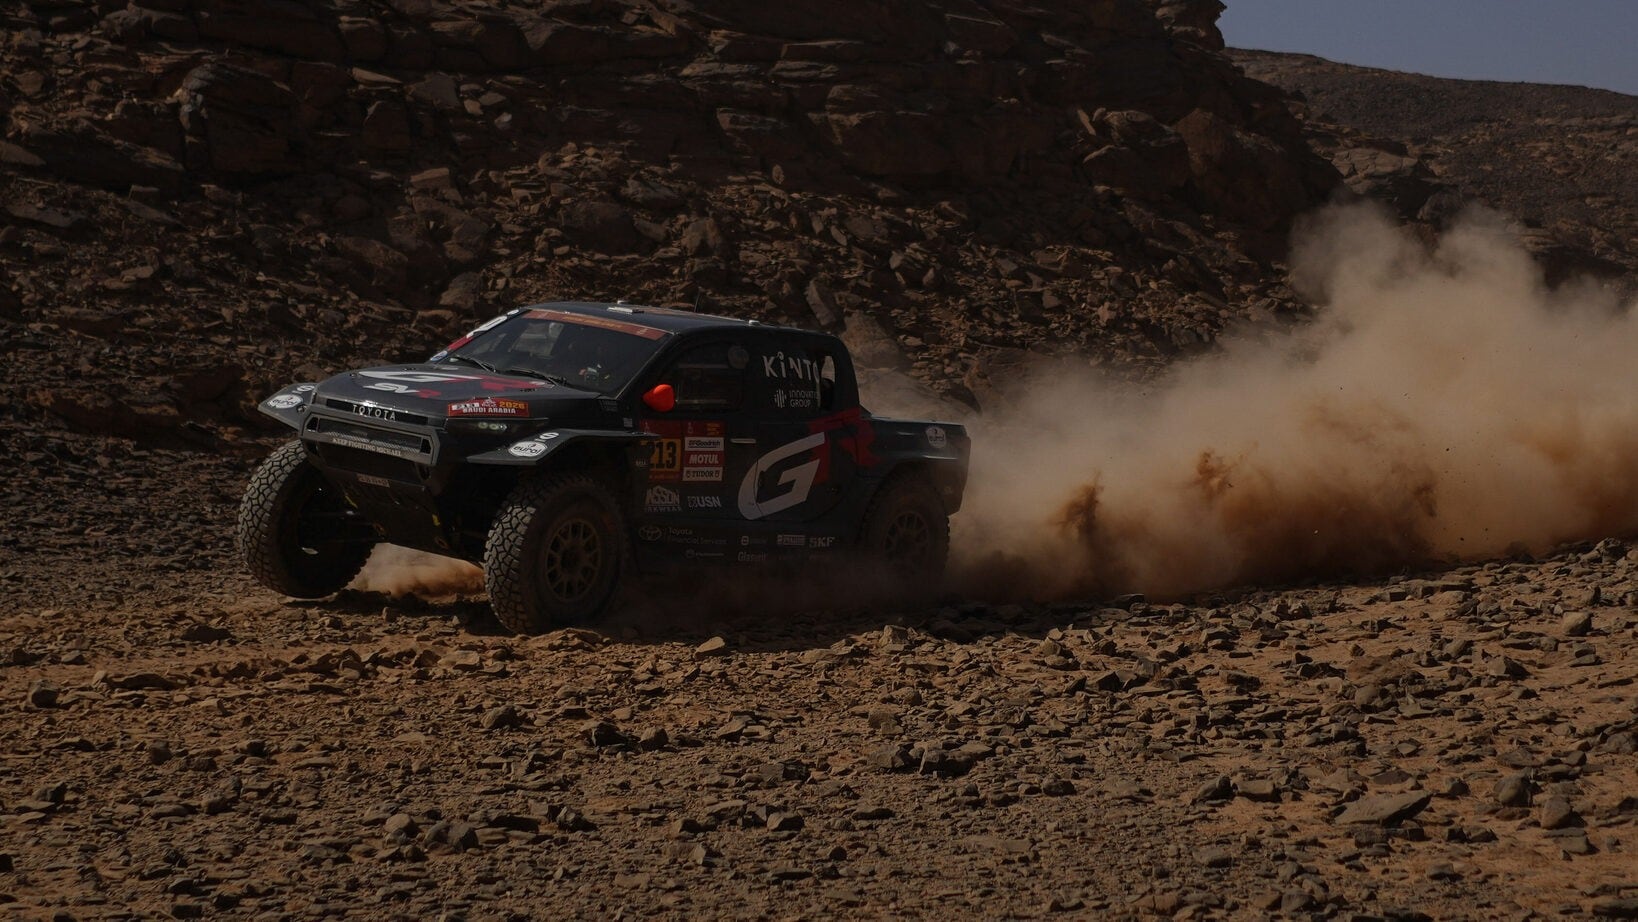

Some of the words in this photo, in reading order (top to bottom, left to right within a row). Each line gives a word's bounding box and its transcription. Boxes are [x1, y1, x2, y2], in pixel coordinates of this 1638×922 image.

[499, 401, 526, 410] 2026
[352, 404, 397, 421] TOYOTA
[348, 440, 376, 452] FIGHTING
[513, 445, 541, 455] eurol
[689, 454, 720, 465] MOTUL
[696, 495, 722, 508] USN
[669, 527, 693, 536] Toyota
[808, 536, 836, 548] SKF
